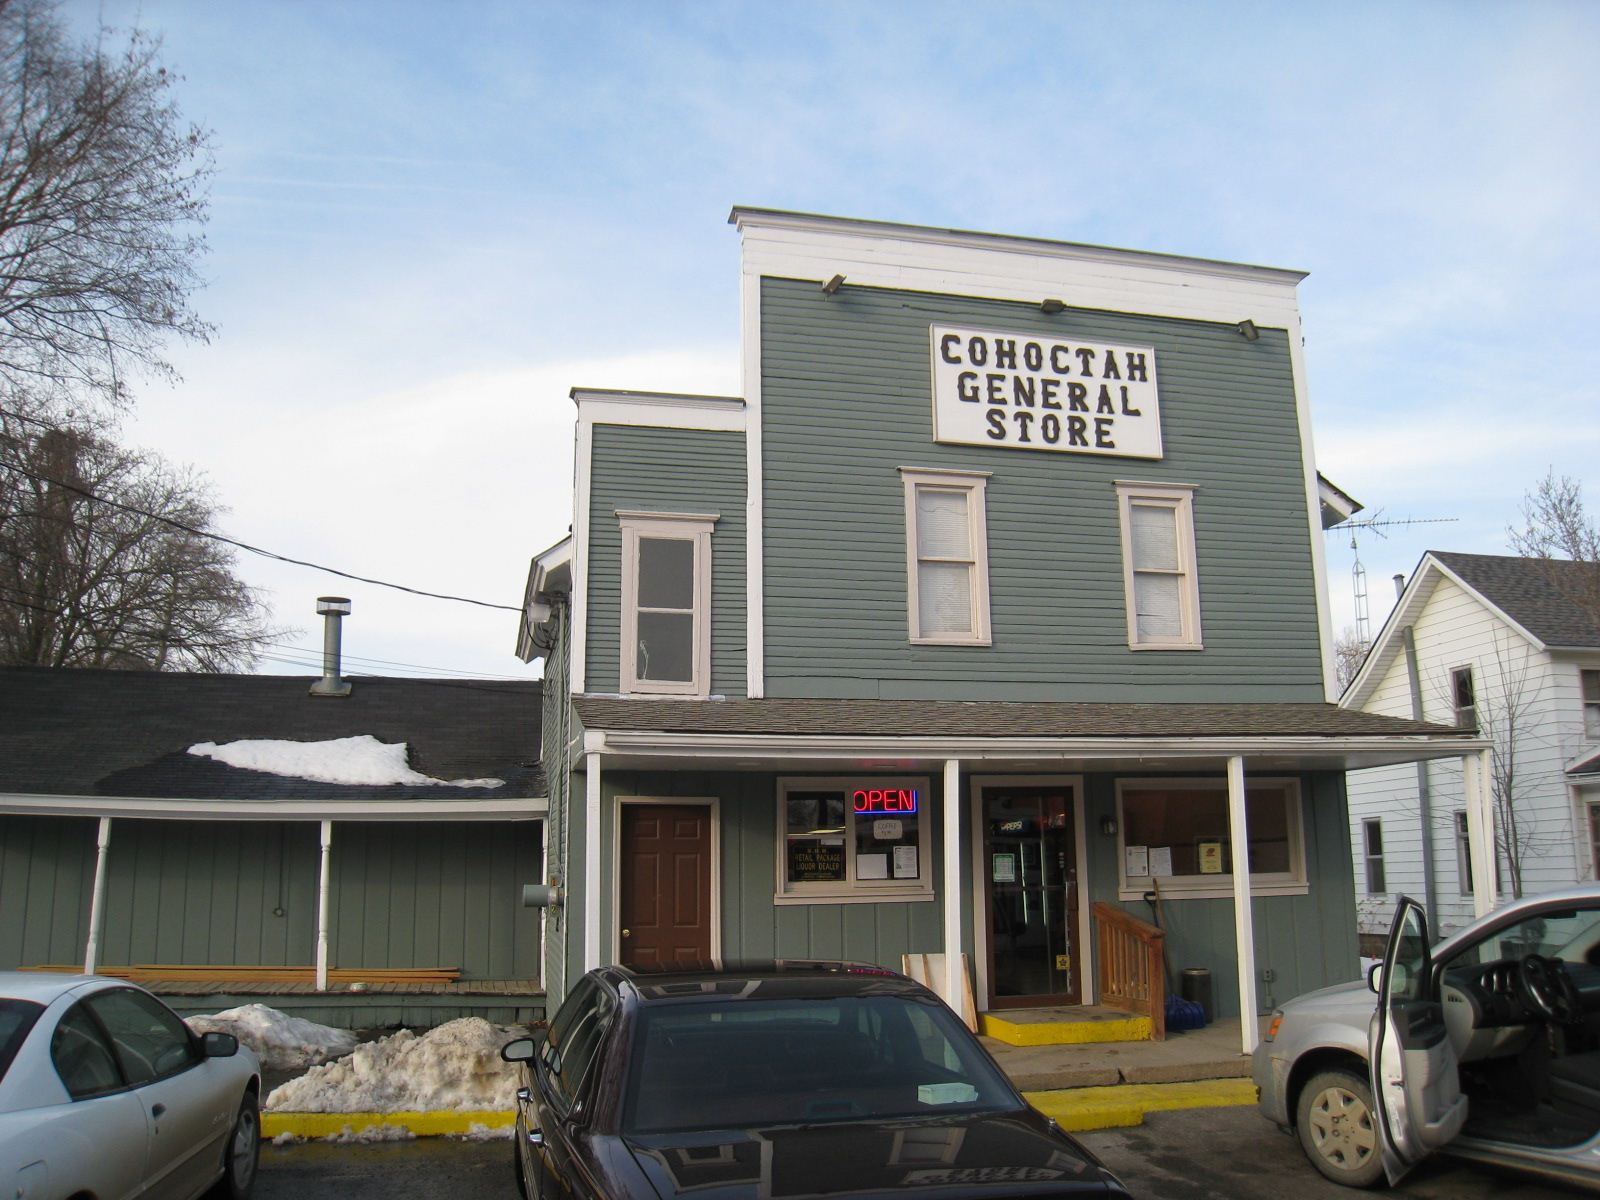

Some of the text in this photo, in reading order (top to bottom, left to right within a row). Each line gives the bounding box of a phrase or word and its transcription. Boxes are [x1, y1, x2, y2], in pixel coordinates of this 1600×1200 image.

[940, 334, 1148, 382] COHOCTAH
[957, 371, 1142, 416] GENERAL
[986, 408, 1115, 448] STORE
[853, 789, 913, 811] OPEN
[818, 862, 840, 871] DEALER
